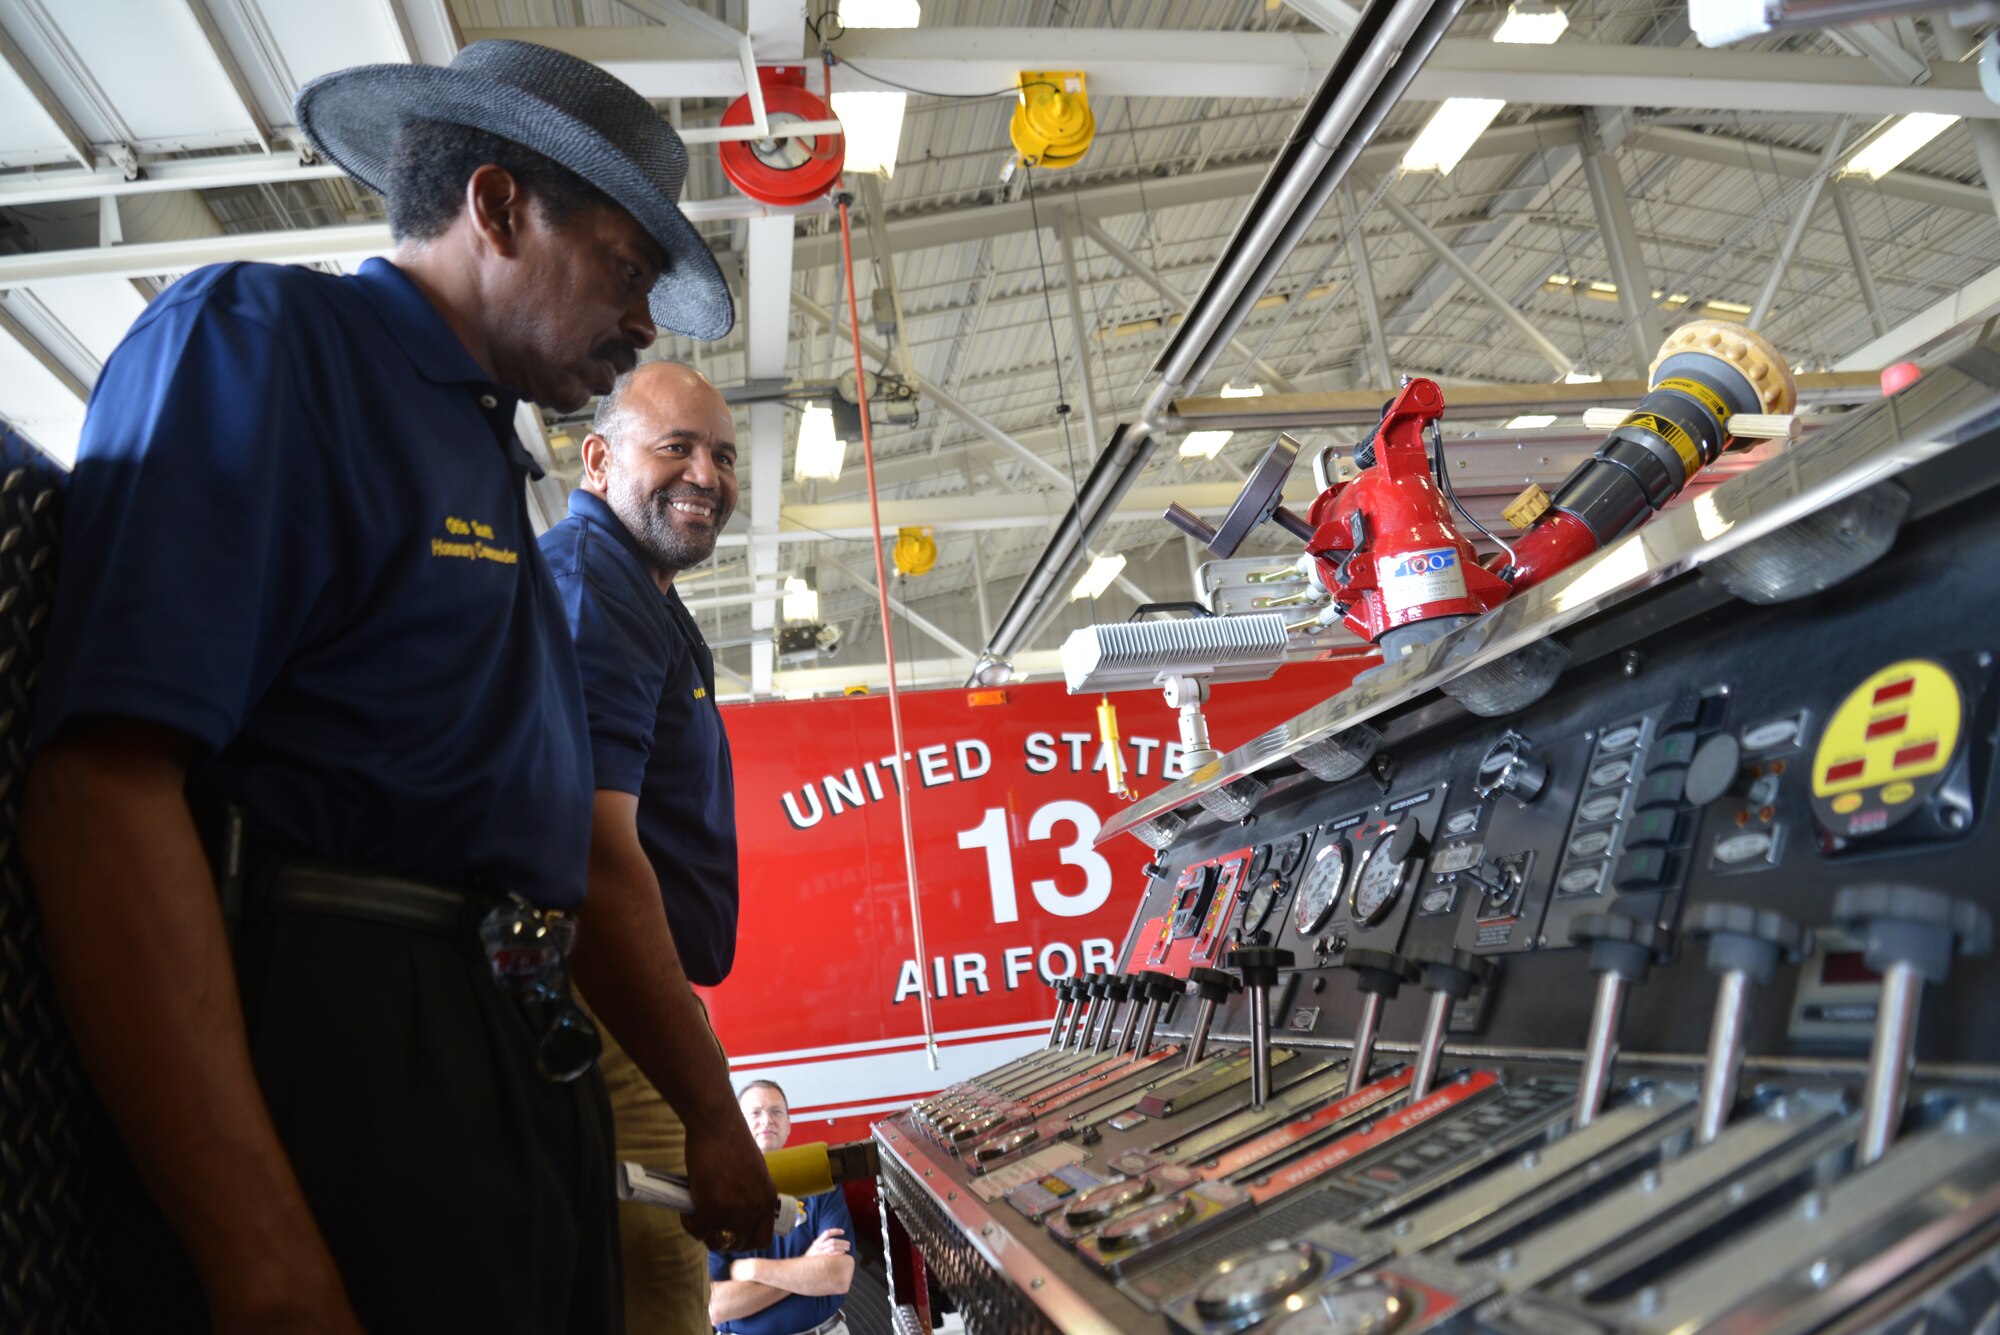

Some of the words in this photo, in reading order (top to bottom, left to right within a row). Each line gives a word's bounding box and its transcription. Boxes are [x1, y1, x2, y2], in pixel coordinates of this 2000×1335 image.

[1400, 554, 1445, 575] 100
[781, 738, 992, 829] UNITED
[1024, 731, 1188, 781] STATE
[956, 799, 1113, 924] 13
[893, 952, 990, 1004] AIR
[1002, 938, 1117, 991] FOR
[1235, 1133, 1293, 1164] WATER
[1338, 1087, 1385, 1114] FOAM
[1285, 1148, 1350, 1184] WATER
[1400, 1096, 1451, 1126] FOAM
